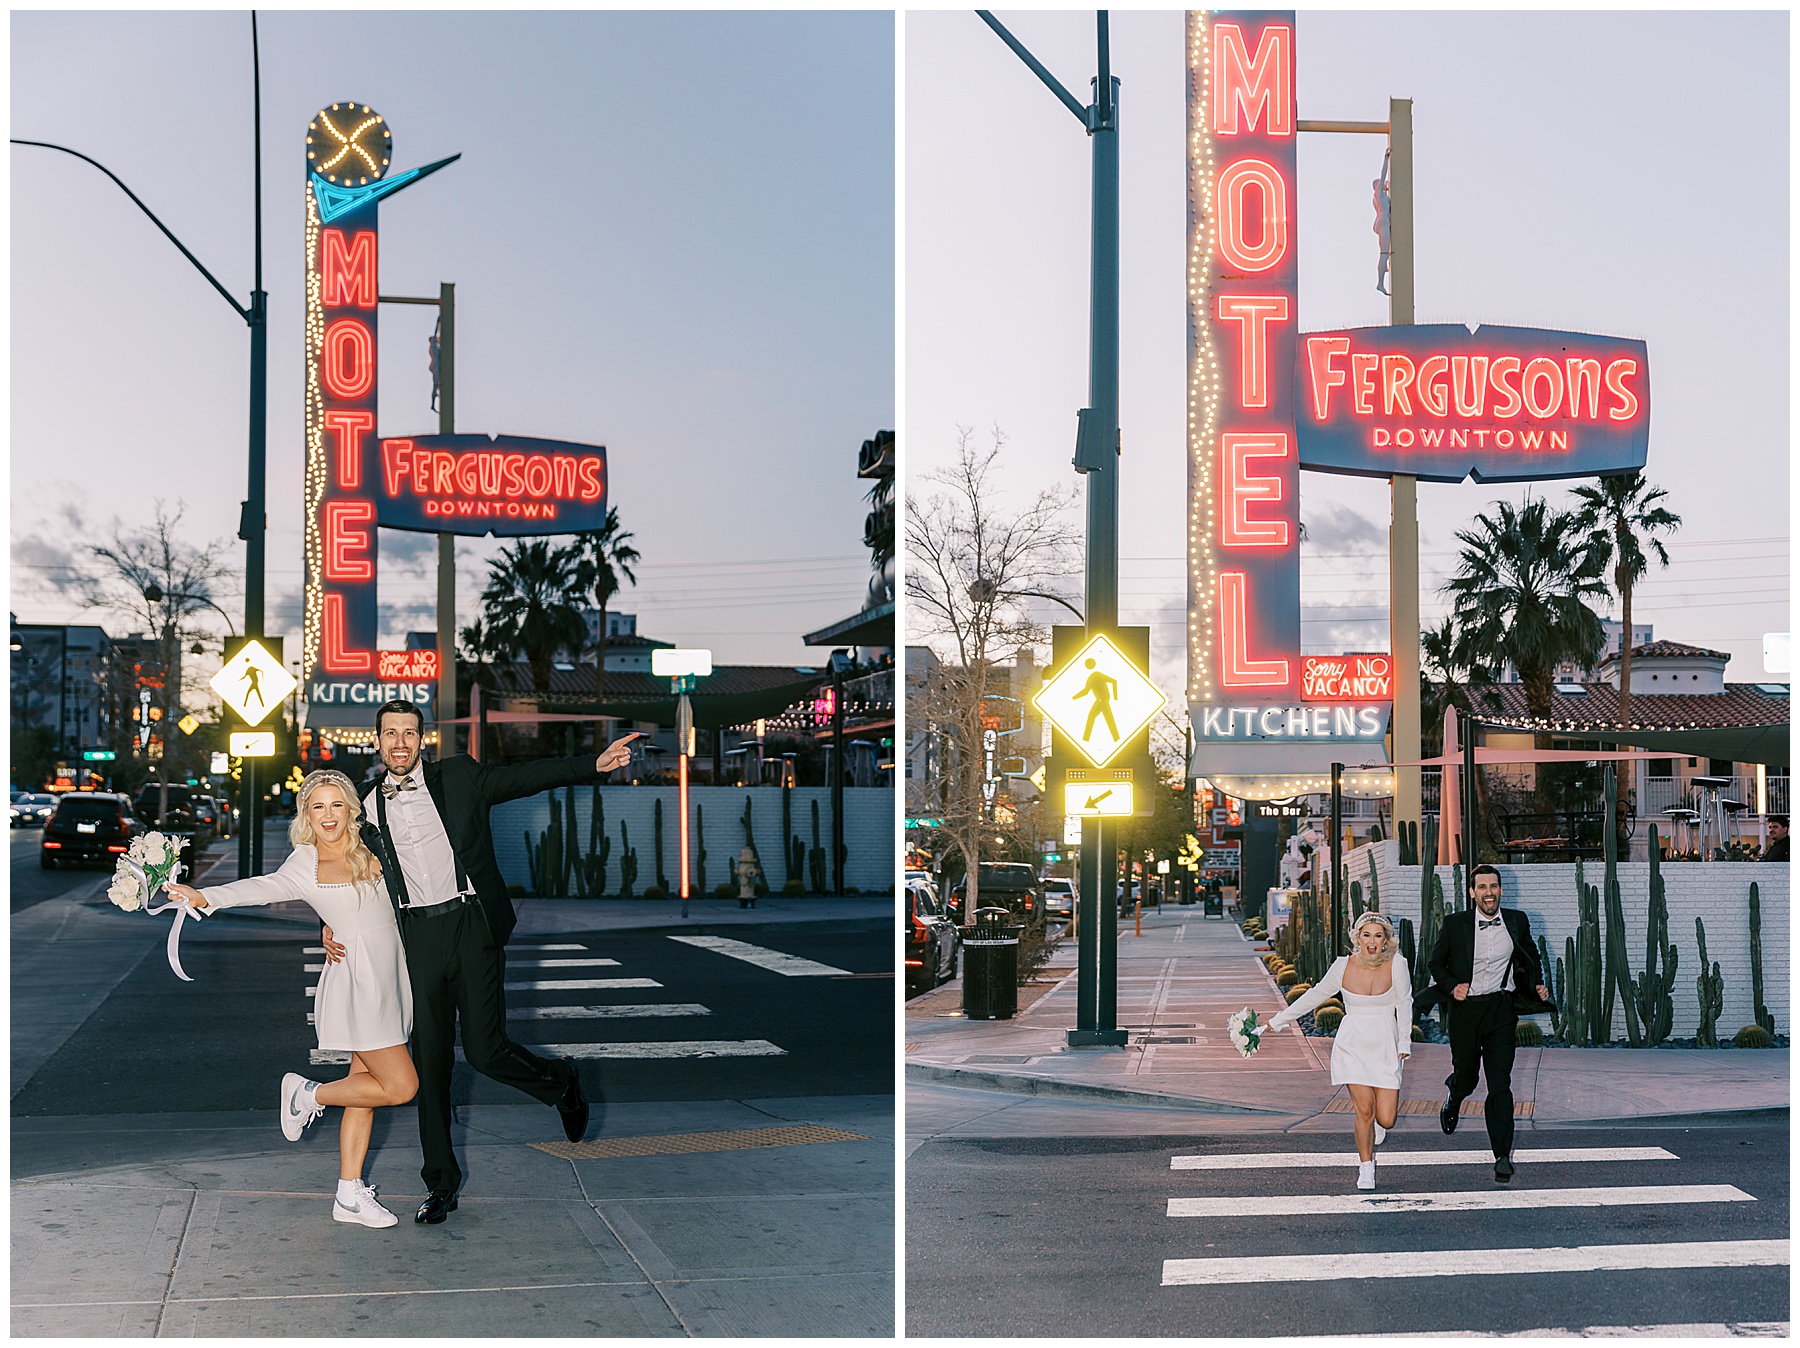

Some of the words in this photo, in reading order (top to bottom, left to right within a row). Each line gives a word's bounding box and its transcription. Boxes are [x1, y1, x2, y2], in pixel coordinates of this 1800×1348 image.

[1213, 24, 1291, 687] MOTEL
[1306, 337, 1640, 421] FERGUSONS
[322, 228, 377, 671] MOTEL
[1373, 428, 1568, 451] DOWNTOWN
[382, 439, 603, 501] FERGUSONS
[426, 500, 557, 519] DOWNTOWN
[414, 651, 436, 664] NO
[379, 662, 438, 678] VACANCY
[1305, 658, 1347, 681] Sorry
[1357, 658, 1389, 676] NO
[313, 682, 430, 704] KITCHENS
[1303, 676, 1391, 697] VACANCY
[1203, 707, 1380, 737] KITCHENS
[1259, 806, 1279, 817] The
[1282, 806, 1301, 817] Bar
